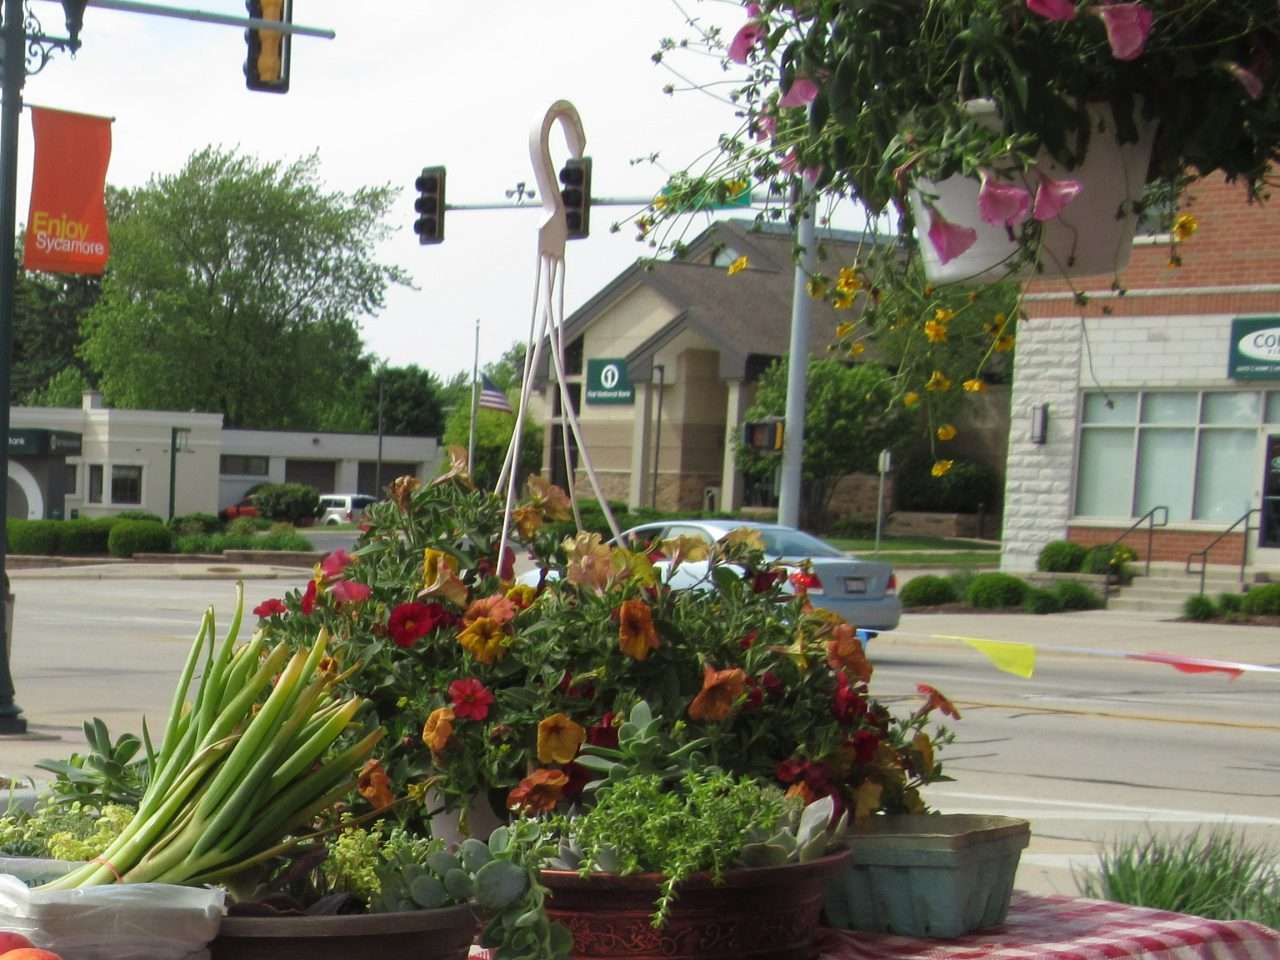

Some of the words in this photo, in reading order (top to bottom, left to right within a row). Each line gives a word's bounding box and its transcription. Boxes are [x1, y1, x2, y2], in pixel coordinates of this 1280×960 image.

[32, 211, 89, 243] Enjoy
[36, 231, 104, 255] Sycamore
[1253, 334, 1280, 349] CO
